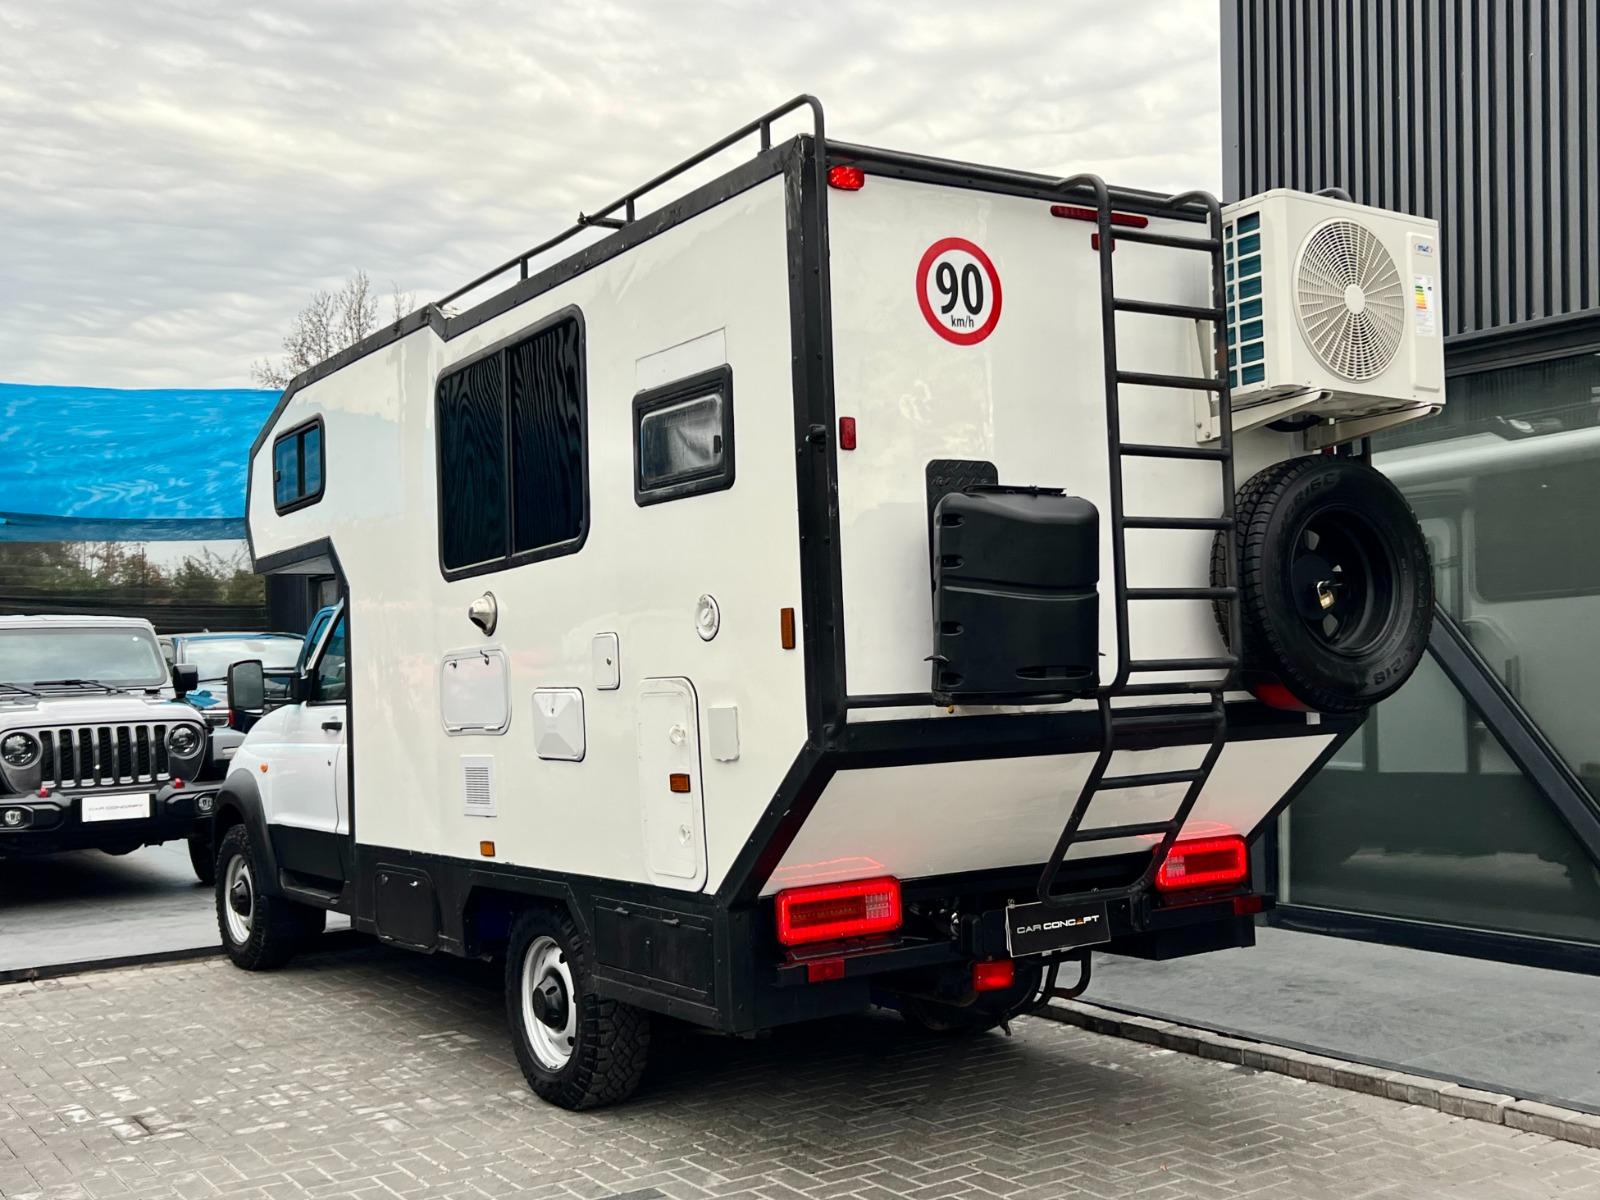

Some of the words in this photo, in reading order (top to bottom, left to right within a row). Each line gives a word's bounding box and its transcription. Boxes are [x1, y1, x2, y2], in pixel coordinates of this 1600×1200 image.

[935, 261, 984, 315] 90
[950, 315, 975, 328] km/h
[1016, 924, 1042, 934] CAR
